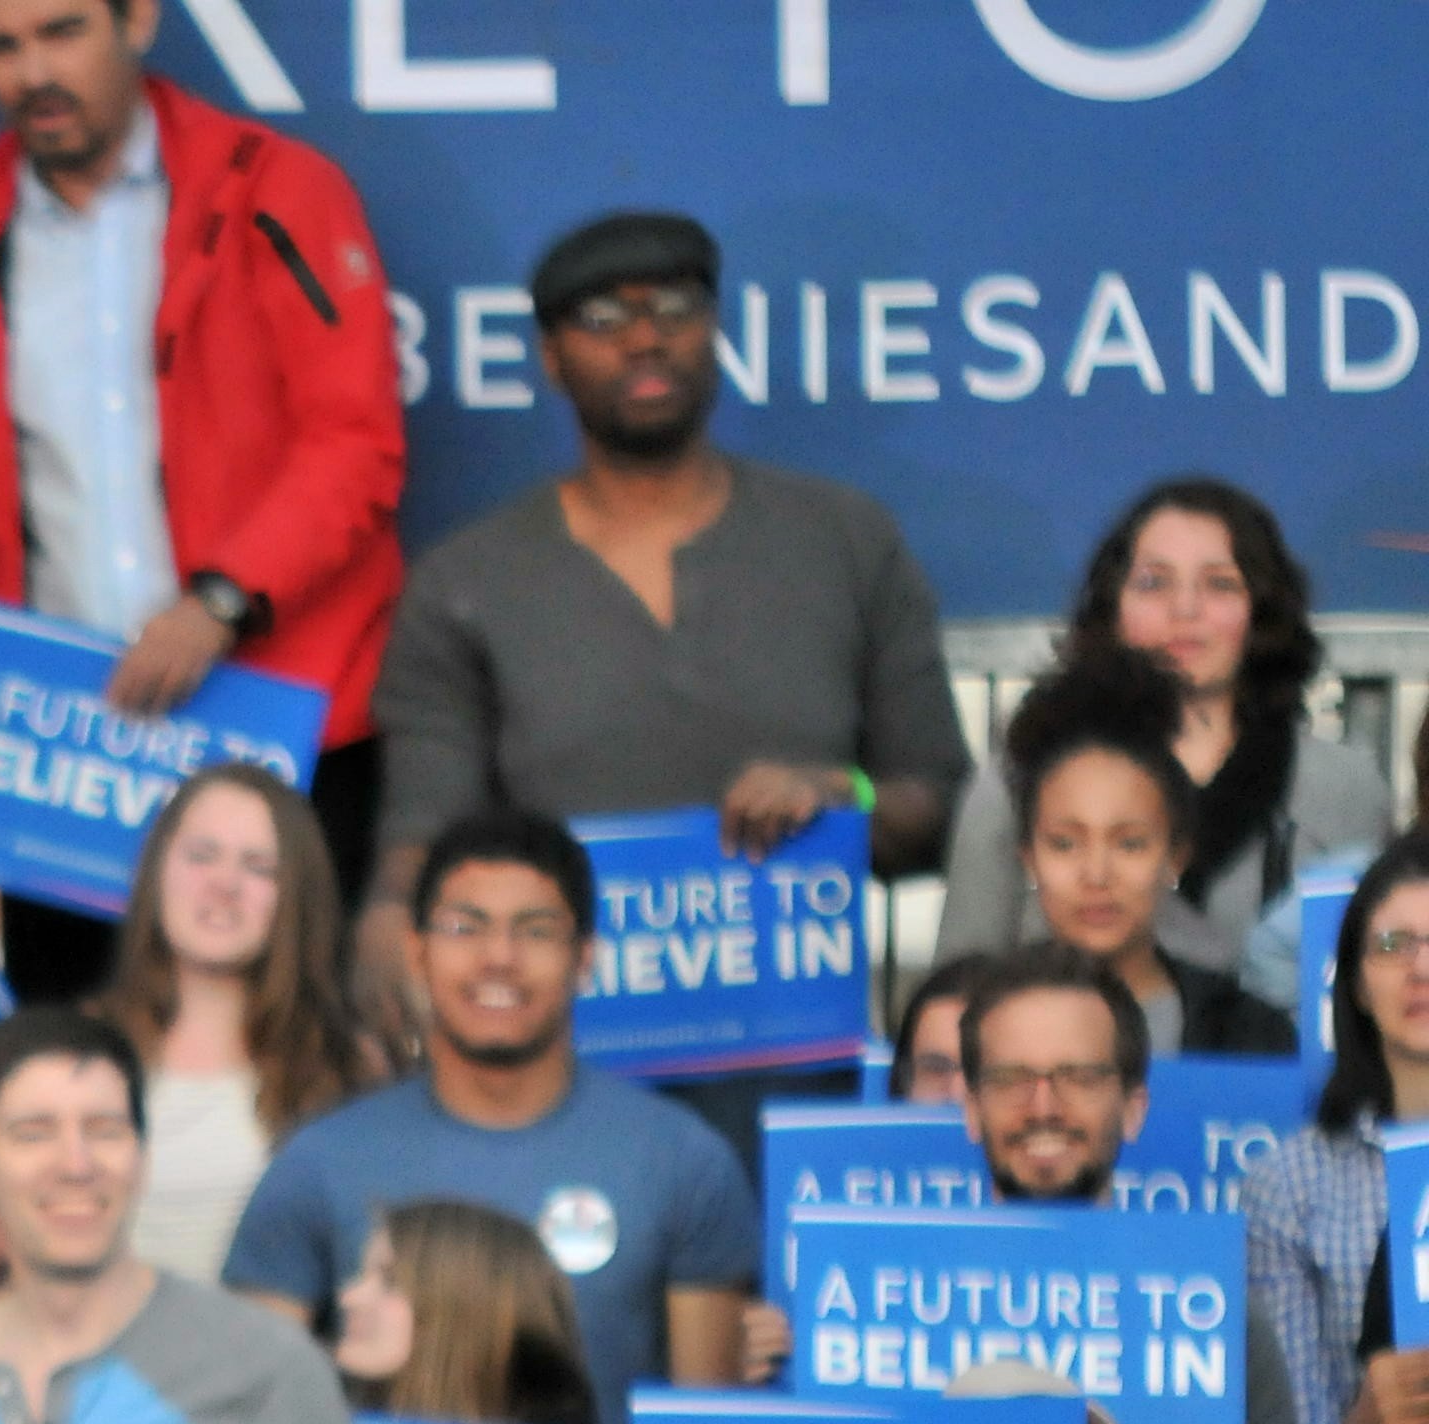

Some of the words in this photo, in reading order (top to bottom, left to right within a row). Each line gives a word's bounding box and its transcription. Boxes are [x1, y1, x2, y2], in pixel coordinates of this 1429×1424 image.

[602, 867, 755, 932] TURE
[767, 863, 854, 916] TO
[599, 926, 758, 998] IEVE
[774, 918, 854, 981] IN
[816, 1265, 858, 1320] A
[872, 1267, 1122, 1330] FUTURE
[1135, 1274, 1227, 1332] TO
[1144, 1334, 1228, 1399] IN
